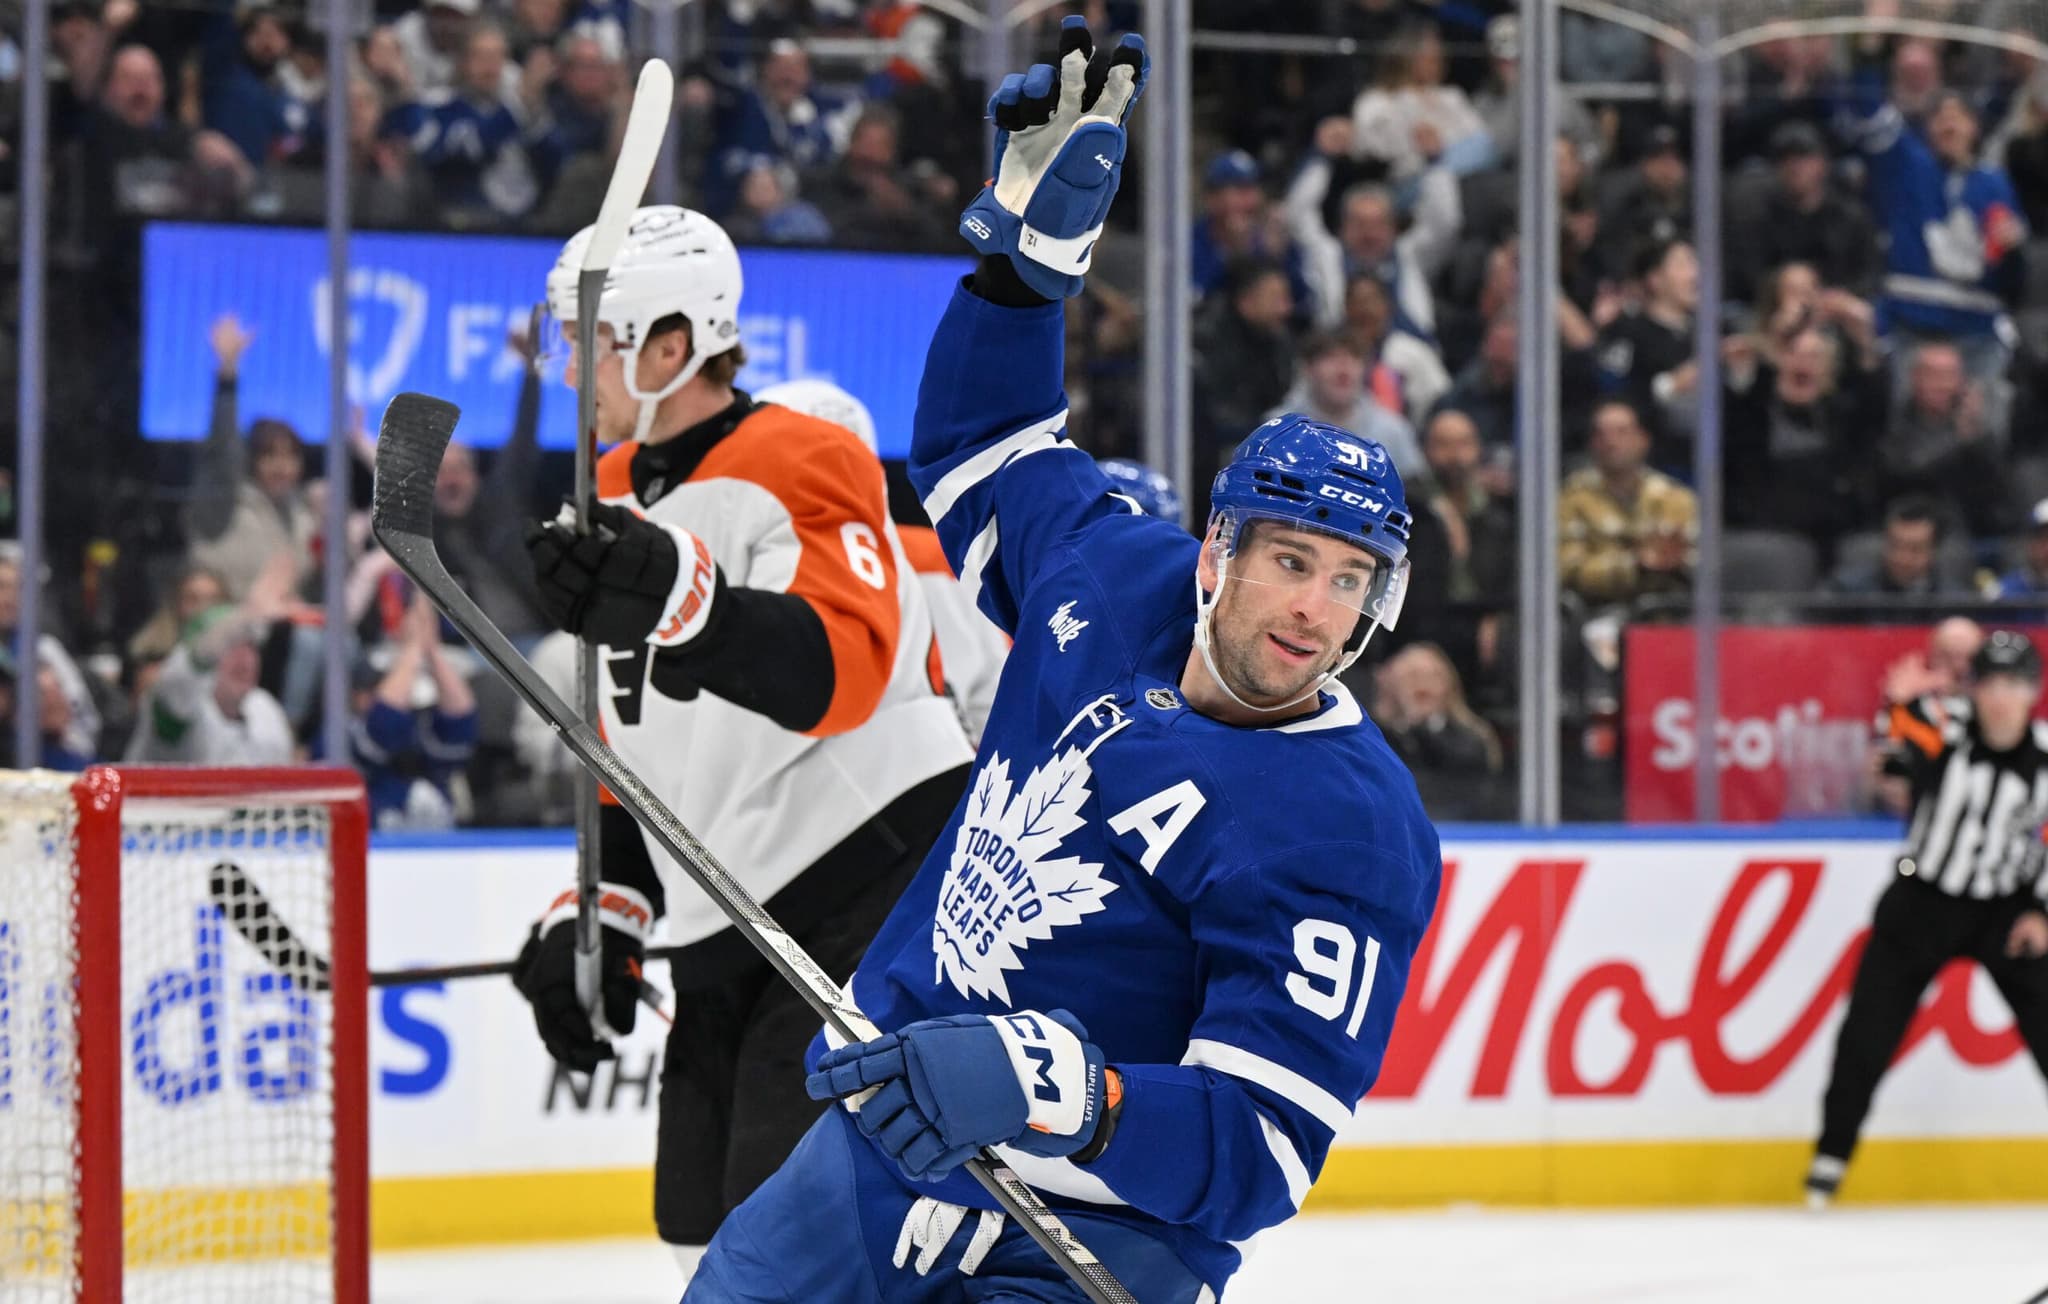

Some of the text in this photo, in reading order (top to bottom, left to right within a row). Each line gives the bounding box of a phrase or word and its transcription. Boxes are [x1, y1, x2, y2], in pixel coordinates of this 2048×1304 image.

[1335, 440, 1369, 471] 91
[1319, 484, 1384, 513] CCM
[839, 522, 886, 590] 6
[1106, 779, 1207, 876] A
[956, 857, 1015, 932] MAPLE
[964, 826, 1043, 924] TORONTO
[942, 884, 996, 957] LEAFS
[1284, 917, 1381, 1041] 91
[543, 1050, 658, 1114] NH
[1003, 1013, 1062, 1104] CM
[1084, 1063, 1097, 1122] MAPLE LEAFS
